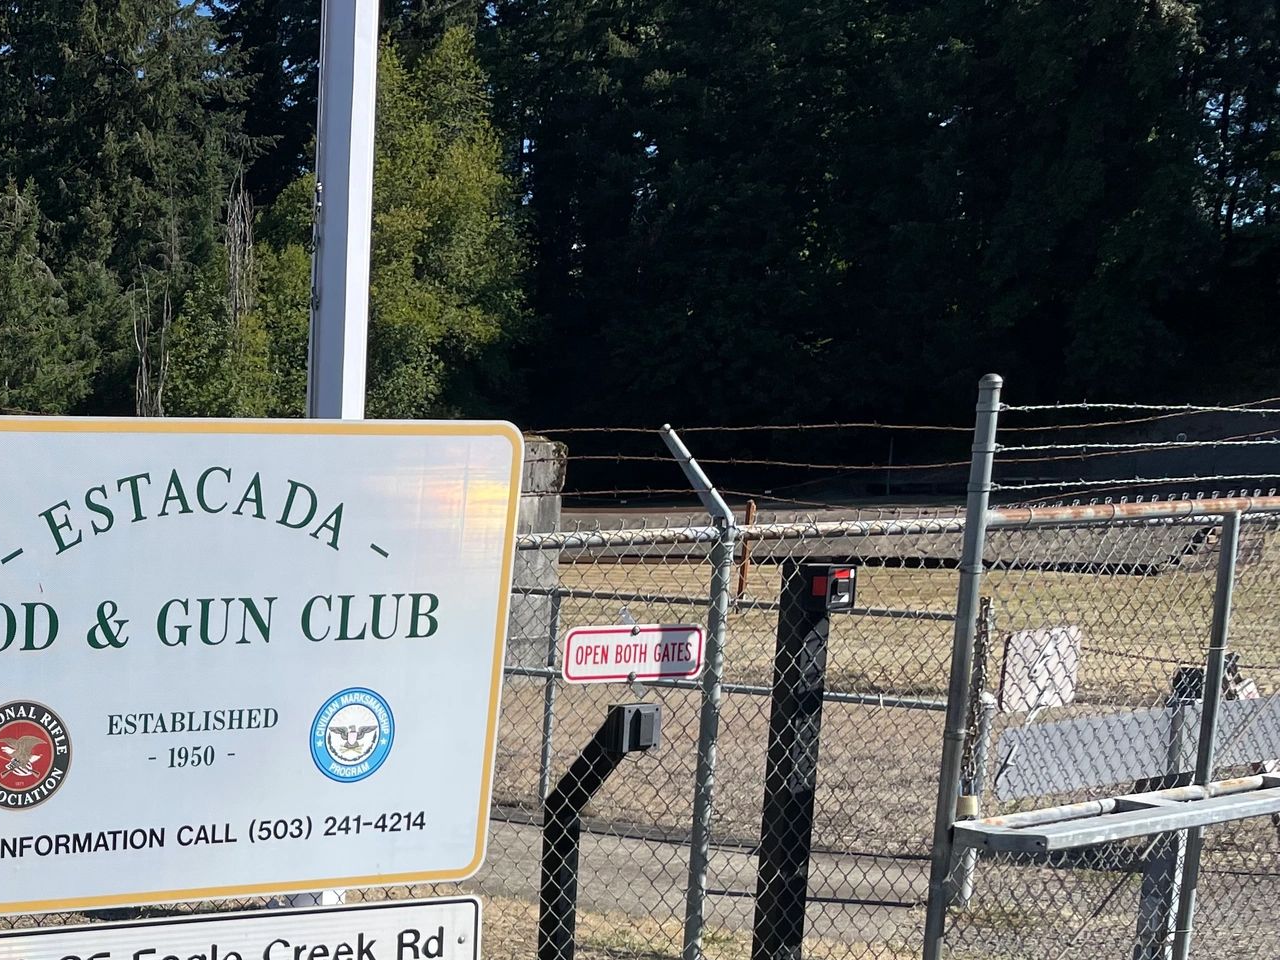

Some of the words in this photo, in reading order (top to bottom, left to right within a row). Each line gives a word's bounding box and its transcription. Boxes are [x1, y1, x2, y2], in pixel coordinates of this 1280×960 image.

[38, 466, 346, 556] ESTACADA
[86, 600, 130, 650] &
[156, 596, 278, 647] GUN
[300, 592, 440, 642] CLUB
[575, 645, 609, 665] OPEN
[615, 643, 647, 664] BOTH
[653, 642, 693, 662] GATES
[106, 708, 279, 736] ESTABLISHED
[316, 701, 340, 737] CIVILIAN
[340, 693, 389, 734] MARKSMANSHIP
[40, 712, 68, 755] RIFLE
[167, 746, 215, 769] 1950
[329, 761, 370, 776] PROGRAM
[176, 823, 238, 848] CALL
[248, 815, 313, 844] (503)
[323, 810, 427, 837] 241-4214
[396, 926, 445, 960] Rd
